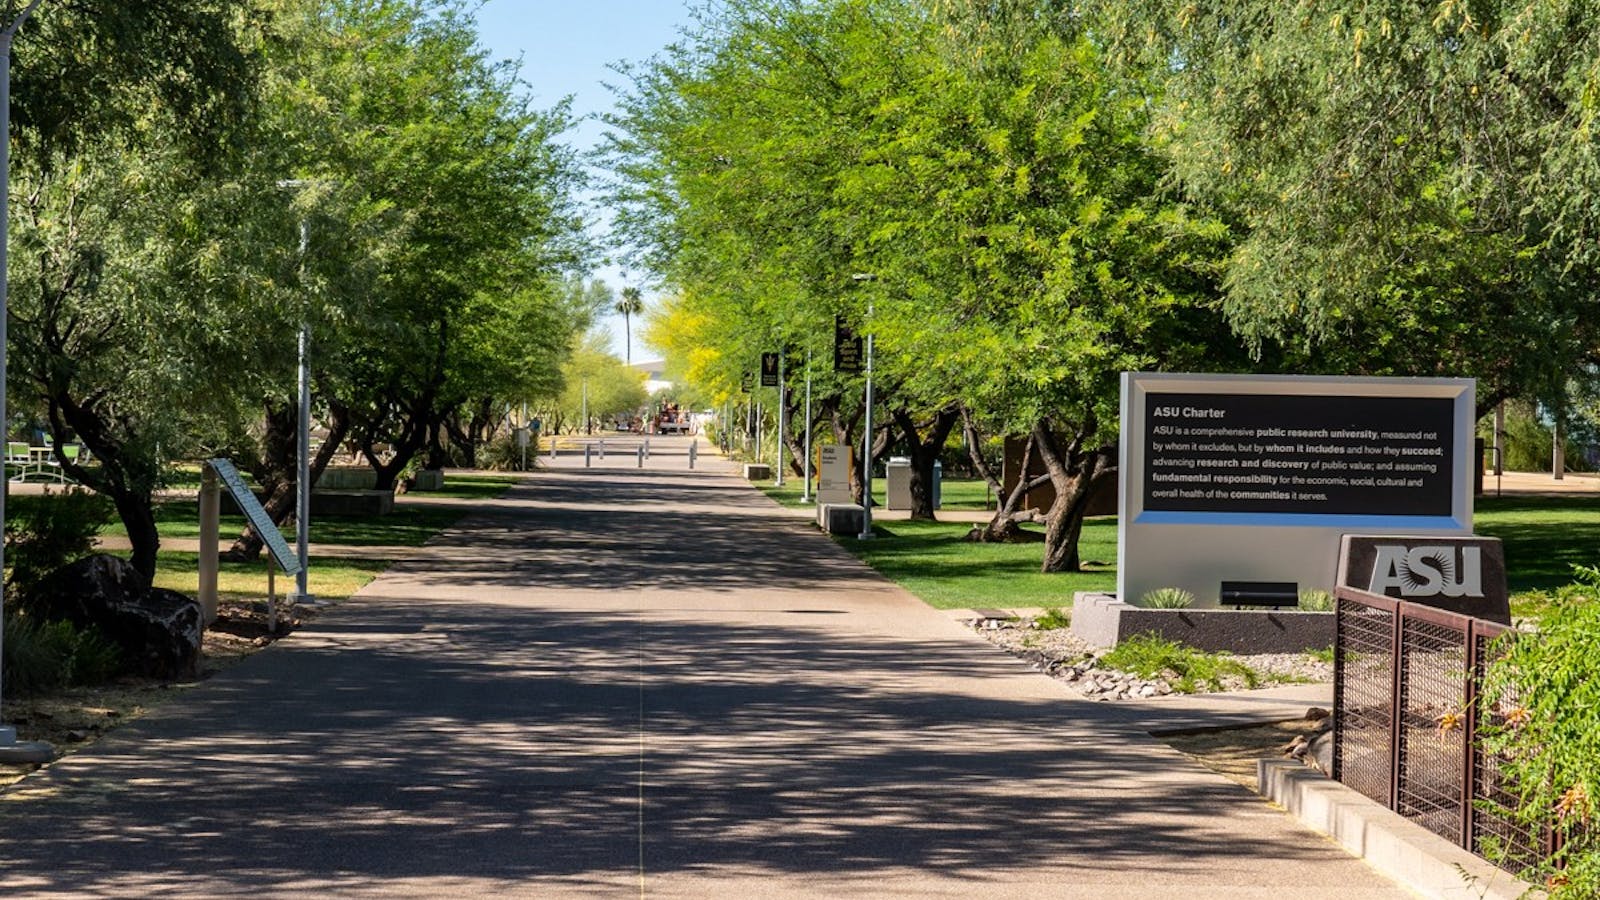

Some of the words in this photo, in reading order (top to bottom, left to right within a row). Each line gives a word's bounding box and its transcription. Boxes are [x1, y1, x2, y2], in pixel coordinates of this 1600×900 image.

[1153, 407, 1180, 417] ASU
[1182, 407, 1226, 418] Charter
[1153, 426, 1174, 435] ASU
[1191, 427, 1254, 437] comprehensive
[1256, 428, 1286, 438] public
[1287, 428, 1328, 438] research
[1330, 429, 1379, 440] university,
[1381, 431, 1422, 439] measured
[1423, 432, 1437, 440] not
[1153, 442, 1163, 452] by
[1165, 442, 1190, 450] whom
[1192, 442, 1197, 451] it
[1198, 443, 1236, 452] excludes,
[1238, 443, 1252, 452] but
[1254, 444, 1264, 454] by
[1265, 444, 1294, 452] whom
[1297, 444, 1304, 453] it
[1306, 444, 1345, 454] includes
[1346, 446, 1363, 454] and
[1364, 446, 1382, 454] how
[1383, 446, 1400, 457] they
[1402, 446, 1443, 456] succeed;
[1152, 458, 1195, 468] advancing
[1197, 458, 1239, 467] research
[1241, 459, 1260, 467] and
[1262, 459, 1309, 470] discovery
[1311, 460, 1320, 469] of
[1321, 461, 1347, 470] public
[1349, 462, 1374, 470] value;
[1376, 462, 1393, 470] and
[1395, 463, 1437, 473] assuming
[1152, 473, 1211, 482] fundamental
[1213, 474, 1278, 485] responsibility
[1280, 475, 1290, 484] for
[1292, 476, 1305, 484] the
[1350, 477, 1375, 486] social,
[1376, 477, 1406, 486] cultural
[1407, 478, 1423, 487] and
[1152, 488, 1178, 498] overall
[1180, 489, 1204, 498] health
[1206, 490, 1214, 498] of
[1216, 490, 1228, 498] the
[1230, 490, 1290, 499] communities
[1292, 492, 1297, 500] it
[1368, 545, 1484, 597] ASU
